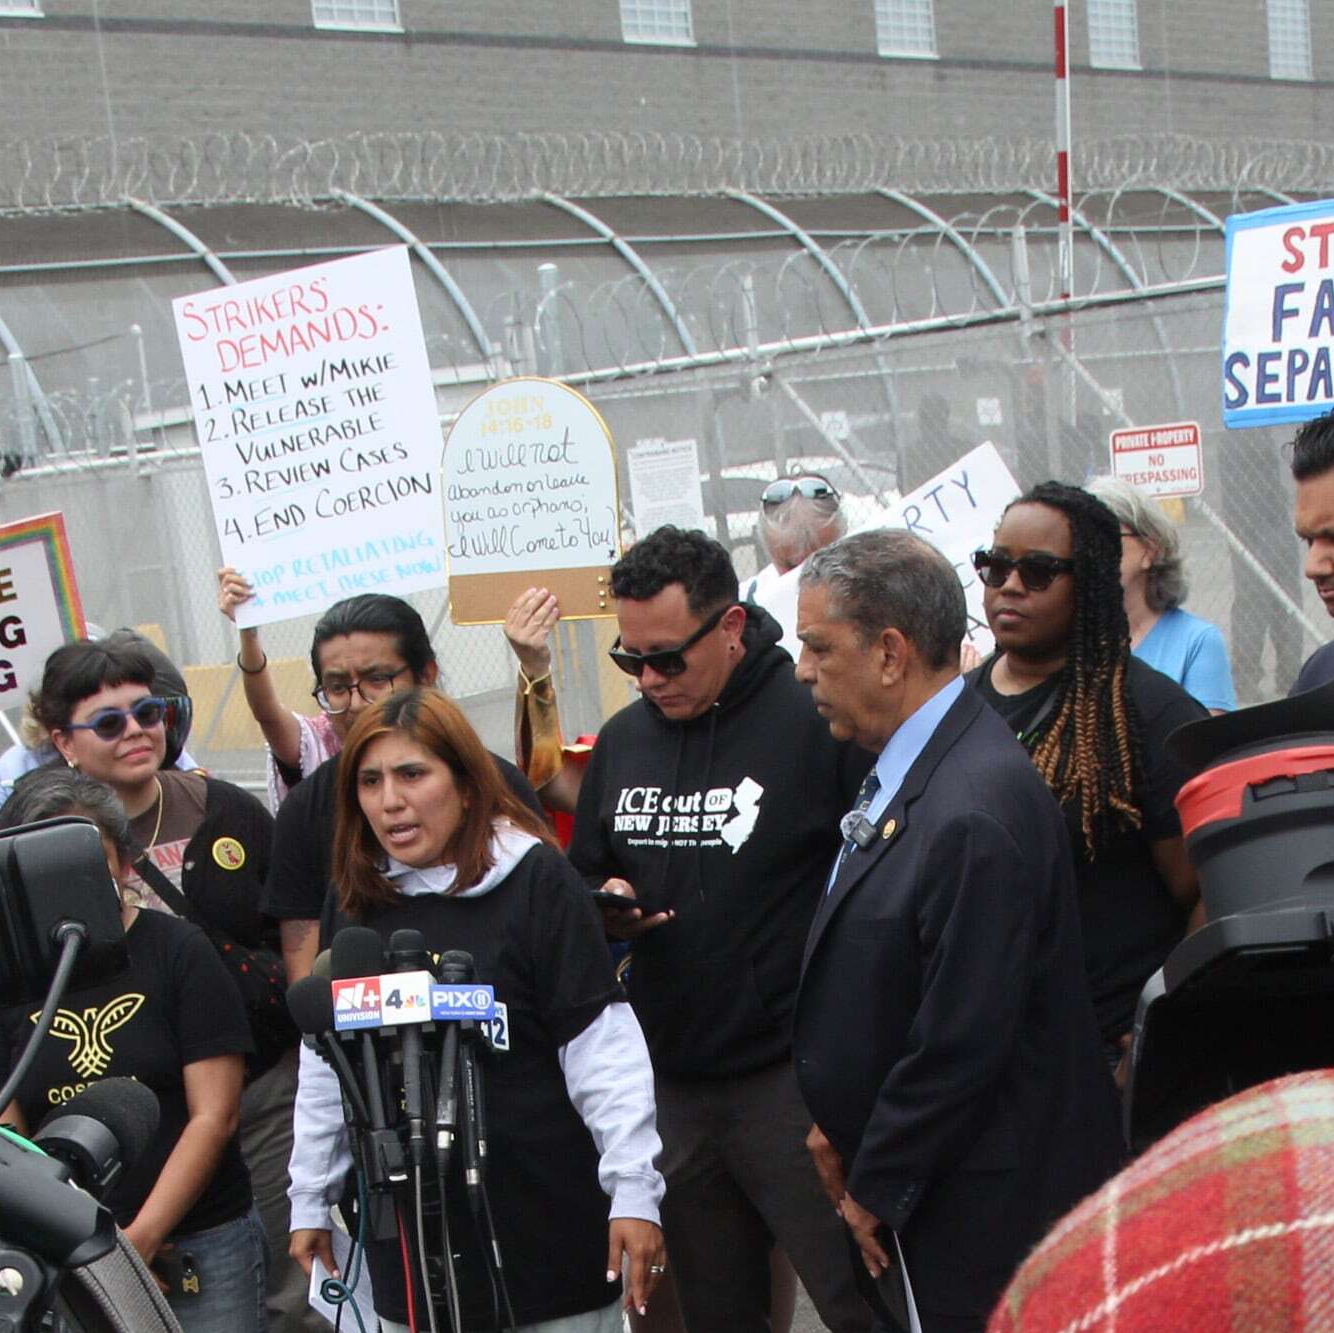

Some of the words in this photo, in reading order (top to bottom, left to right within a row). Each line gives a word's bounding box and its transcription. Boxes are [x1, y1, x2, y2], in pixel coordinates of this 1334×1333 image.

[216, 304, 391, 373] DEMANDS:
[224, 371, 289, 406] MEET
[231, 394, 337, 436] RELEASE
[344, 381, 388, 408] THE
[235, 411, 386, 466] VULNERABLE
[1151, 429, 1196, 447] PROPERTY
[245, 457, 332, 496] REVIEW
[339, 442, 409, 473] CASES
[1148, 454, 1165, 467] NO
[254, 503, 306, 538] END
[315, 472, 434, 520] COERCION
[245, 563, 285, 590] TOP
[615, 786, 662, 814] ICE
[661, 791, 703, 813] out
[708, 793, 729, 807] OF
[613, 815, 653, 832] NEW
[655, 814, 729, 837] JERSEY
[384, 988, 404, 1010] 4
[337, 1010, 381, 1023] UNIVISION
